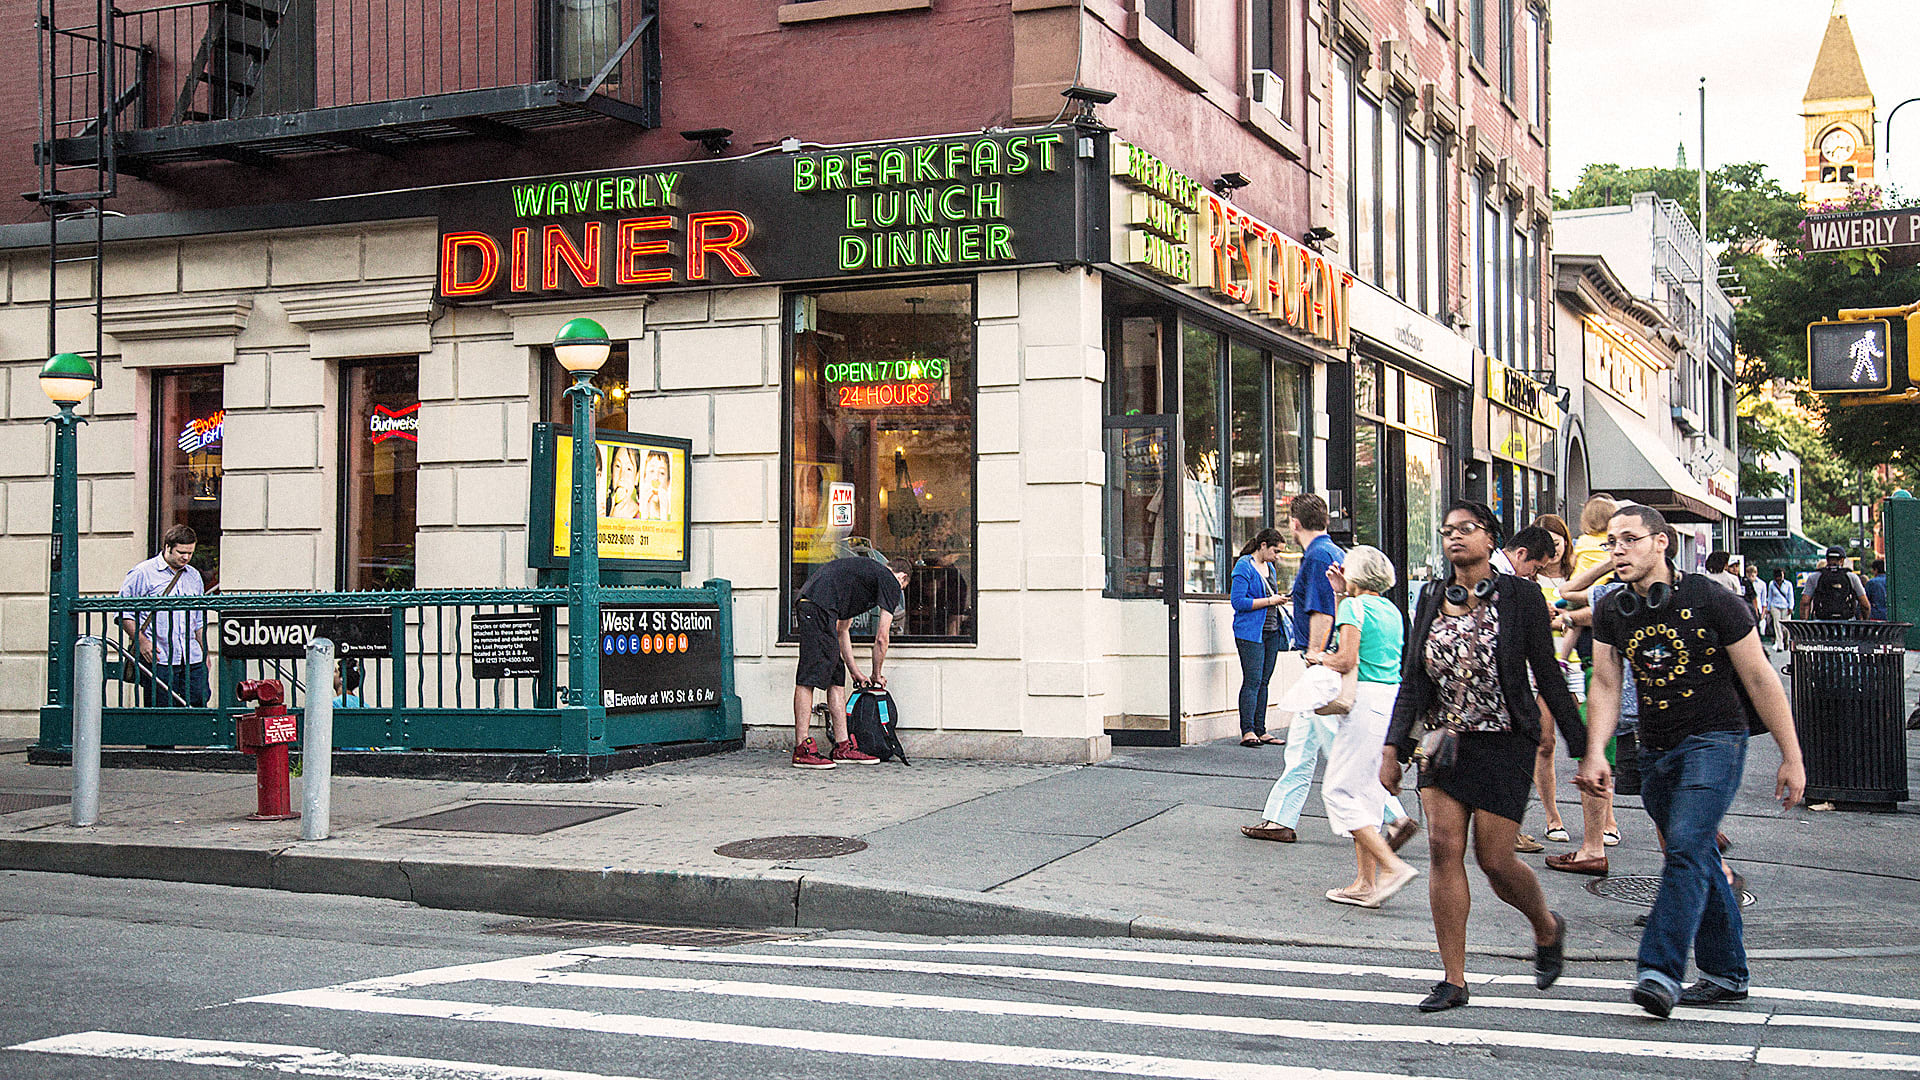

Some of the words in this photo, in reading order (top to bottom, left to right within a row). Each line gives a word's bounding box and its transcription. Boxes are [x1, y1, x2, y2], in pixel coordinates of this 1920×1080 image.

[793, 132, 1063, 193] BREAKFAST
[1127, 142, 1203, 214] BREAKFAST
[512, 171, 681, 218] WAVERLY
[846, 181, 1005, 231] LUNCH
[1143, 192, 1189, 244] LUNCH
[440, 210, 761, 298] DINER
[838, 224, 1014, 271] DINNER
[1142, 229, 1192, 284] DINNER
[1810, 216, 1897, 250] WAVERLY
[1208, 195, 1354, 350] RESTAURANT
[824, 361, 874, 383] OPEN
[877, 361, 889, 381] 7
[894, 358, 943, 381] DAYS
[838, 386, 863, 407] 24
[866, 383, 930, 406] HOURS
[833, 489, 852, 502] ATM
[640, 535, 649, 546] 311
[223, 619, 318, 650] Subway
[602, 611, 635, 632] West
[638, 611, 649, 631] 4
[652, 611, 667, 631] St
[670, 611, 712, 631] Station
[615, 692, 648, 707] Elevator
[650, 691, 659, 705] at
[661, 690, 674, 704] W3
[676, 690, 686, 703] St
[687, 690, 694, 702] &
[696, 689, 703, 701] 6
[704, 688, 715, 701] Av
